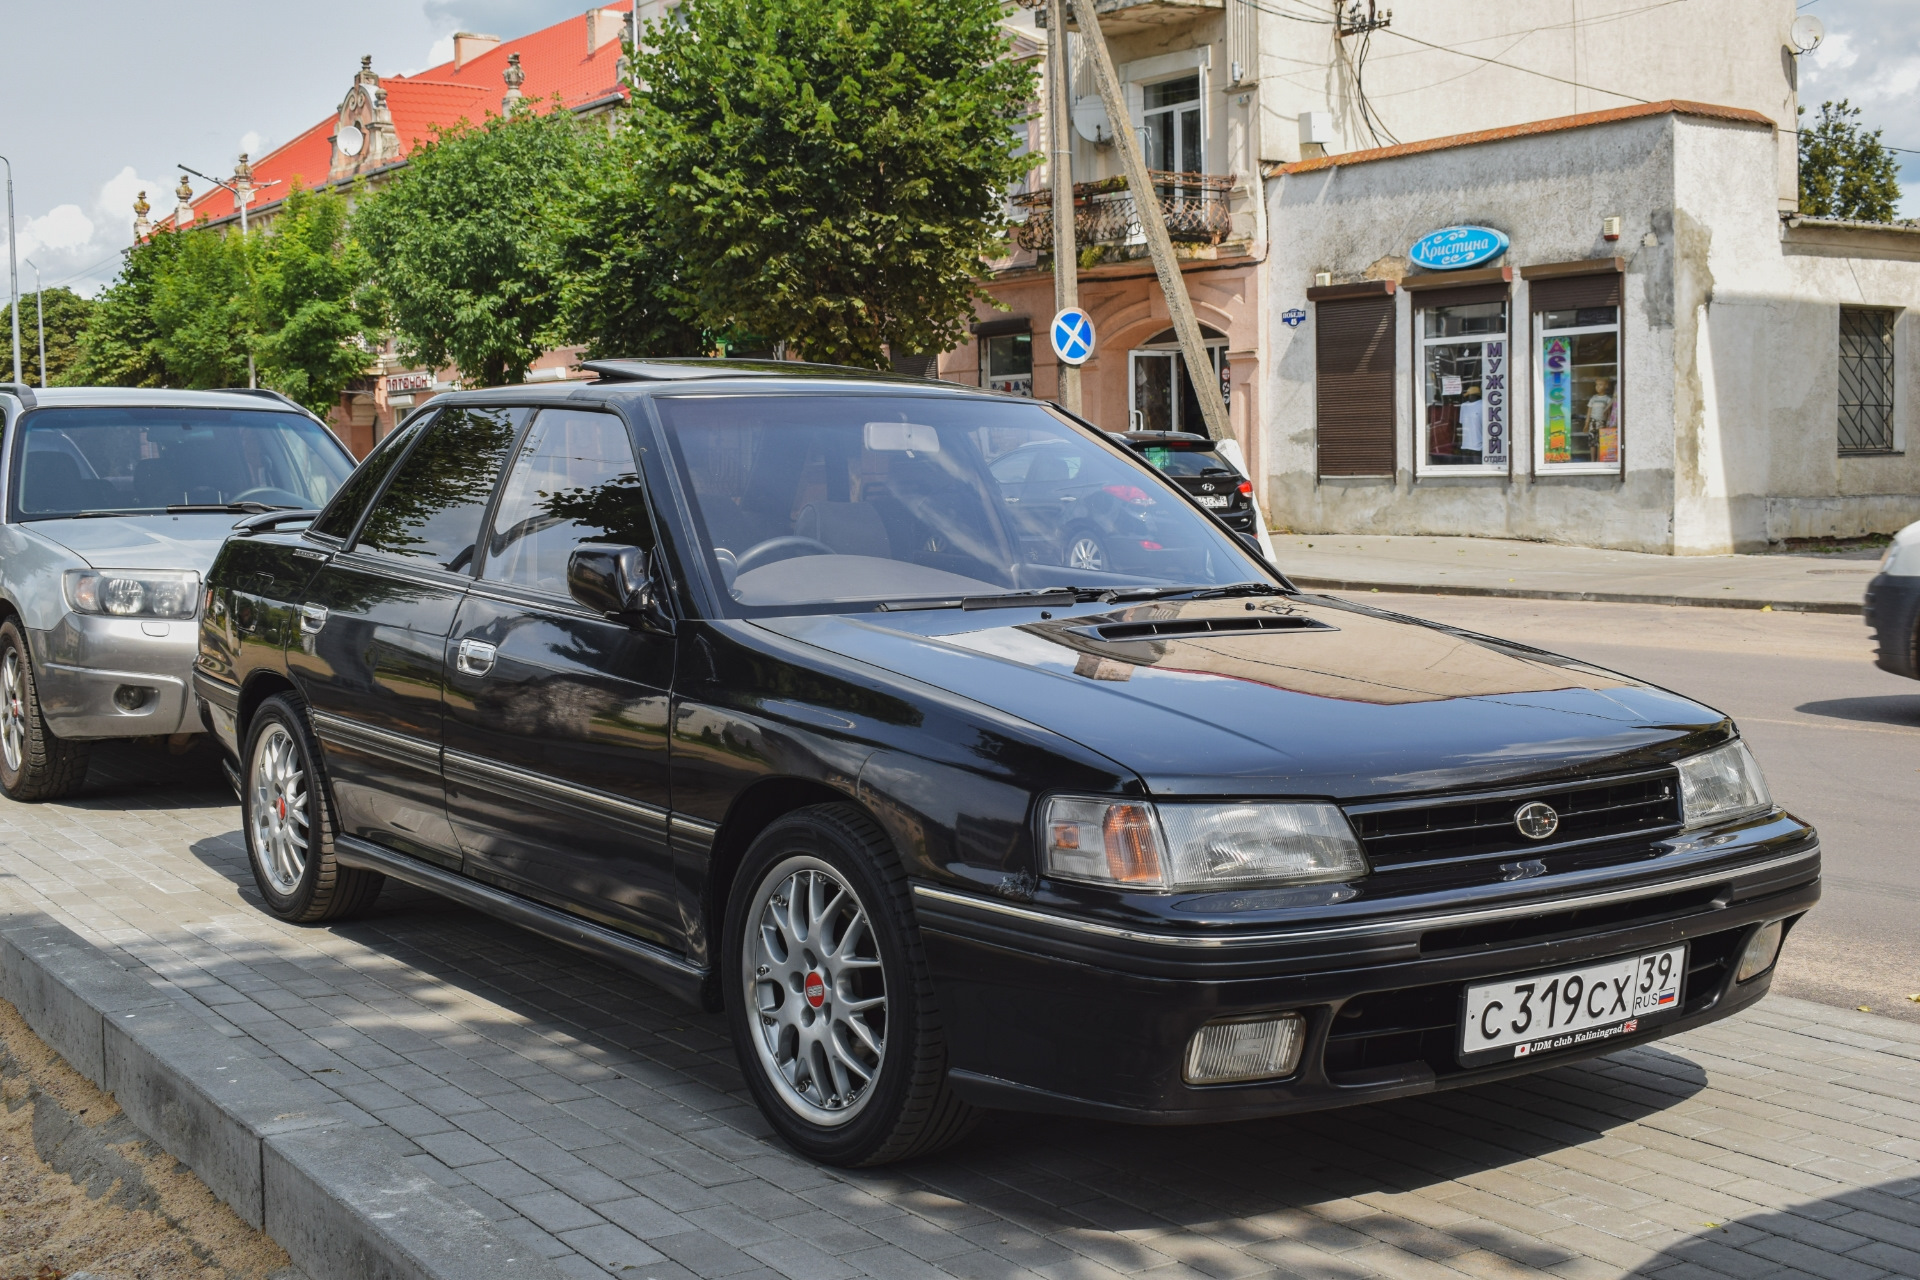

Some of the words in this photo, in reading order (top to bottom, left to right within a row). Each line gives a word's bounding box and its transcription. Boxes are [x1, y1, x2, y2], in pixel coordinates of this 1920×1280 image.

[1420, 238, 1489, 261] Кристина
[1486, 342, 1504, 454] МУЖСКОЙ
[1483, 455, 1507, 464] ОТДЕЛ
[1640, 952, 1673, 994] 39
[1634, 992, 1658, 1010] RUS
[1531, 1040, 1553, 1053] JDM
[1553, 1035, 1573, 1048] club
[1574, 1023, 1624, 1044] Kaliningrad
